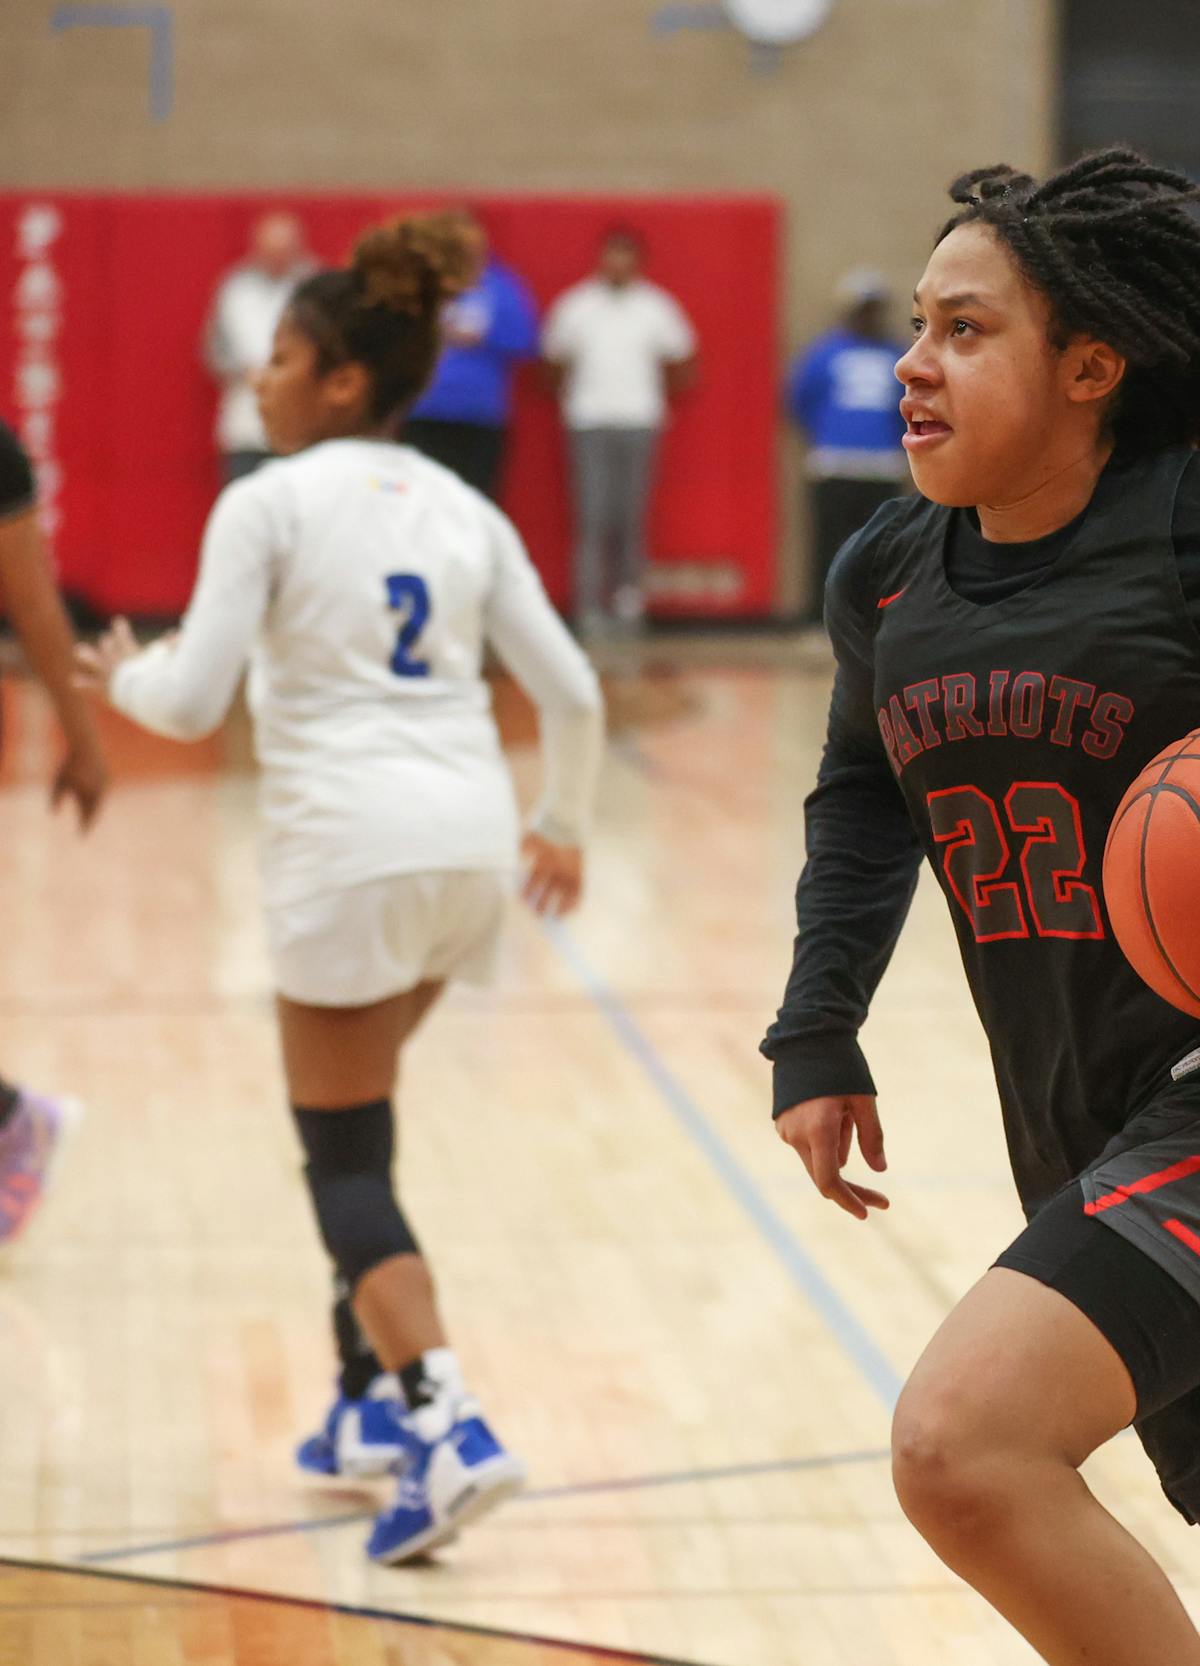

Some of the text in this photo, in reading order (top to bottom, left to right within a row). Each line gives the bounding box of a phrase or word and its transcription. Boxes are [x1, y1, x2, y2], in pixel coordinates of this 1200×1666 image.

[385, 573, 430, 677] 2
[877, 670, 1135, 778] PATRIOTS
[926, 781, 1104, 943] 22
